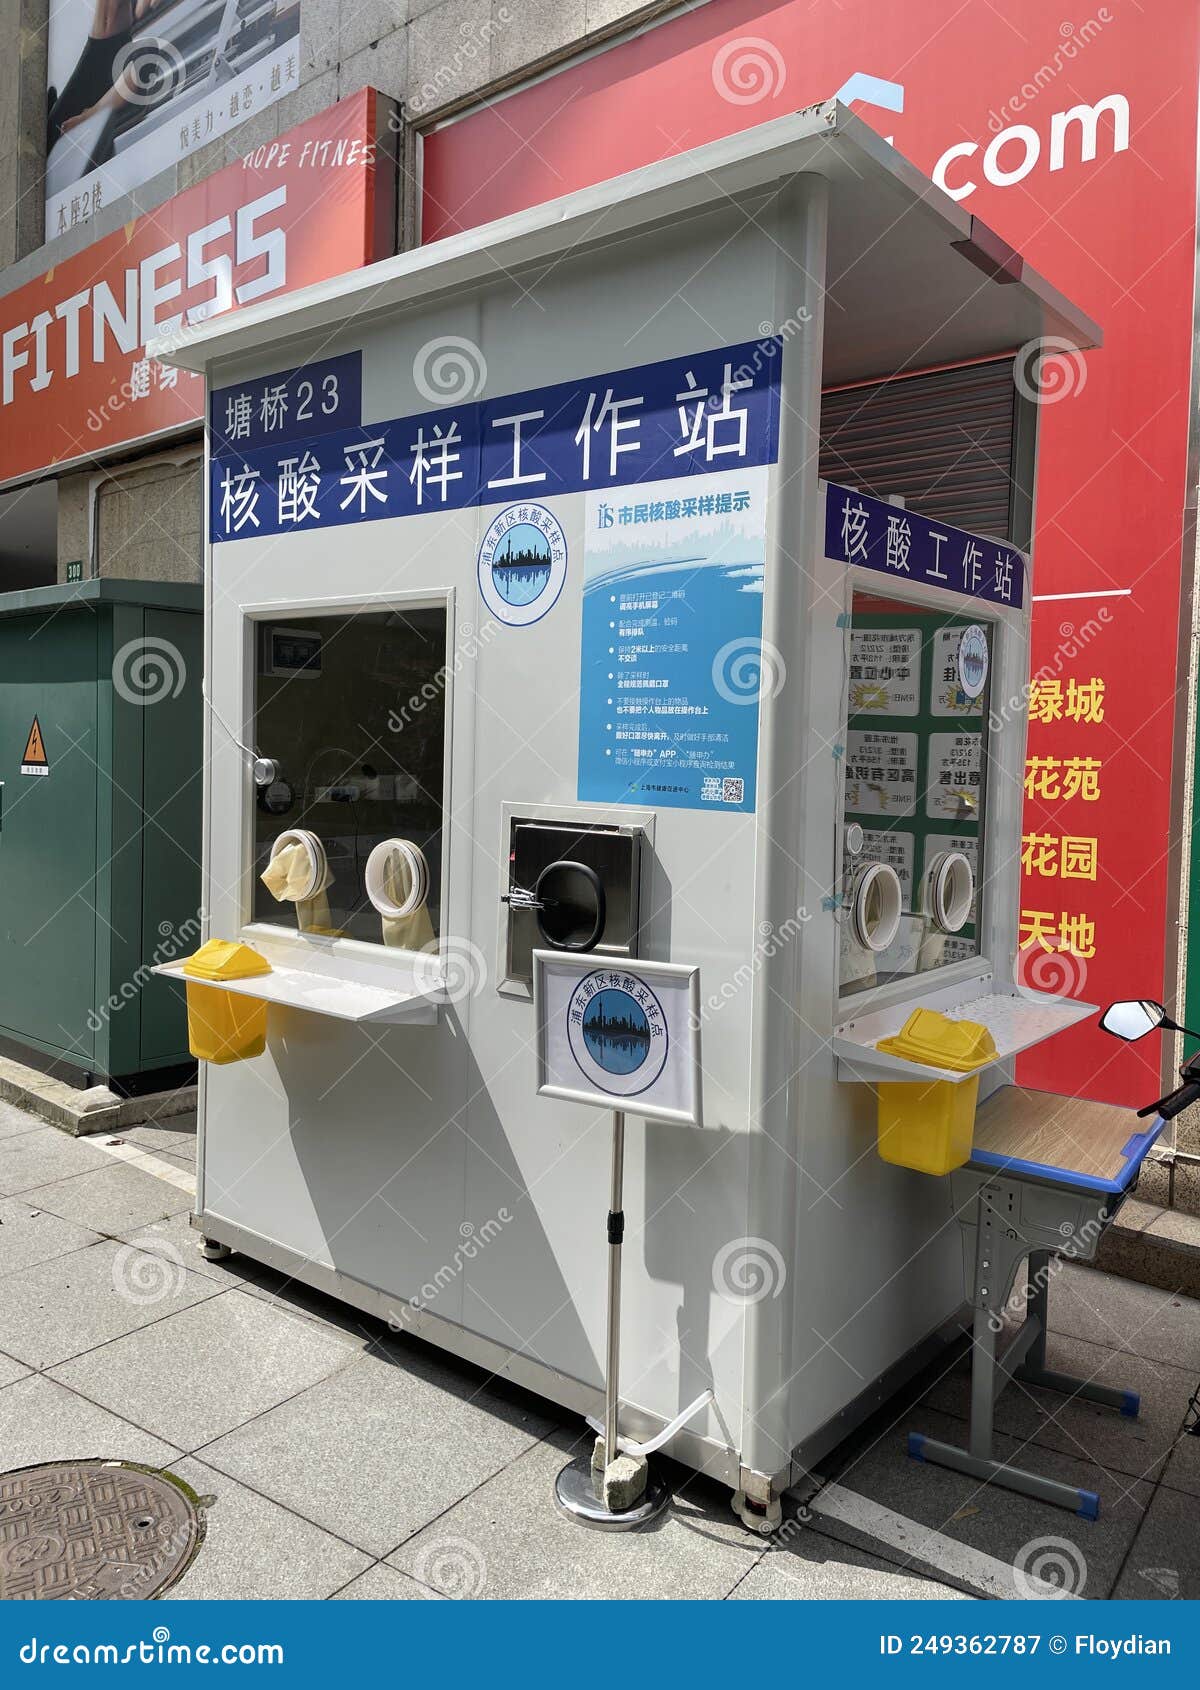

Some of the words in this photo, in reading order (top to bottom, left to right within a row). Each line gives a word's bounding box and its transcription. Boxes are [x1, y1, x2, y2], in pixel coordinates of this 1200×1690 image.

[2, 184, 287, 406] FITNESS
[130, 359, 199, 402] 健身
[224, 373, 340, 441] 塘桥23
[219, 363, 754, 534] 核酸采样工作站
[618, 490, 750, 526] 市民核酸采样提示
[482, 507, 564, 566] 浦东新区核酸采样点
[841, 497, 1013, 601] 核酸工作站
[1028, 678, 1105, 725] 绿城
[1024, 756, 1102, 801] 花苑
[1021, 832, 1098, 881] 花园
[1019, 909, 1096, 959] 天地
[571, 973, 663, 1037] 浦东新区核酸采样点
